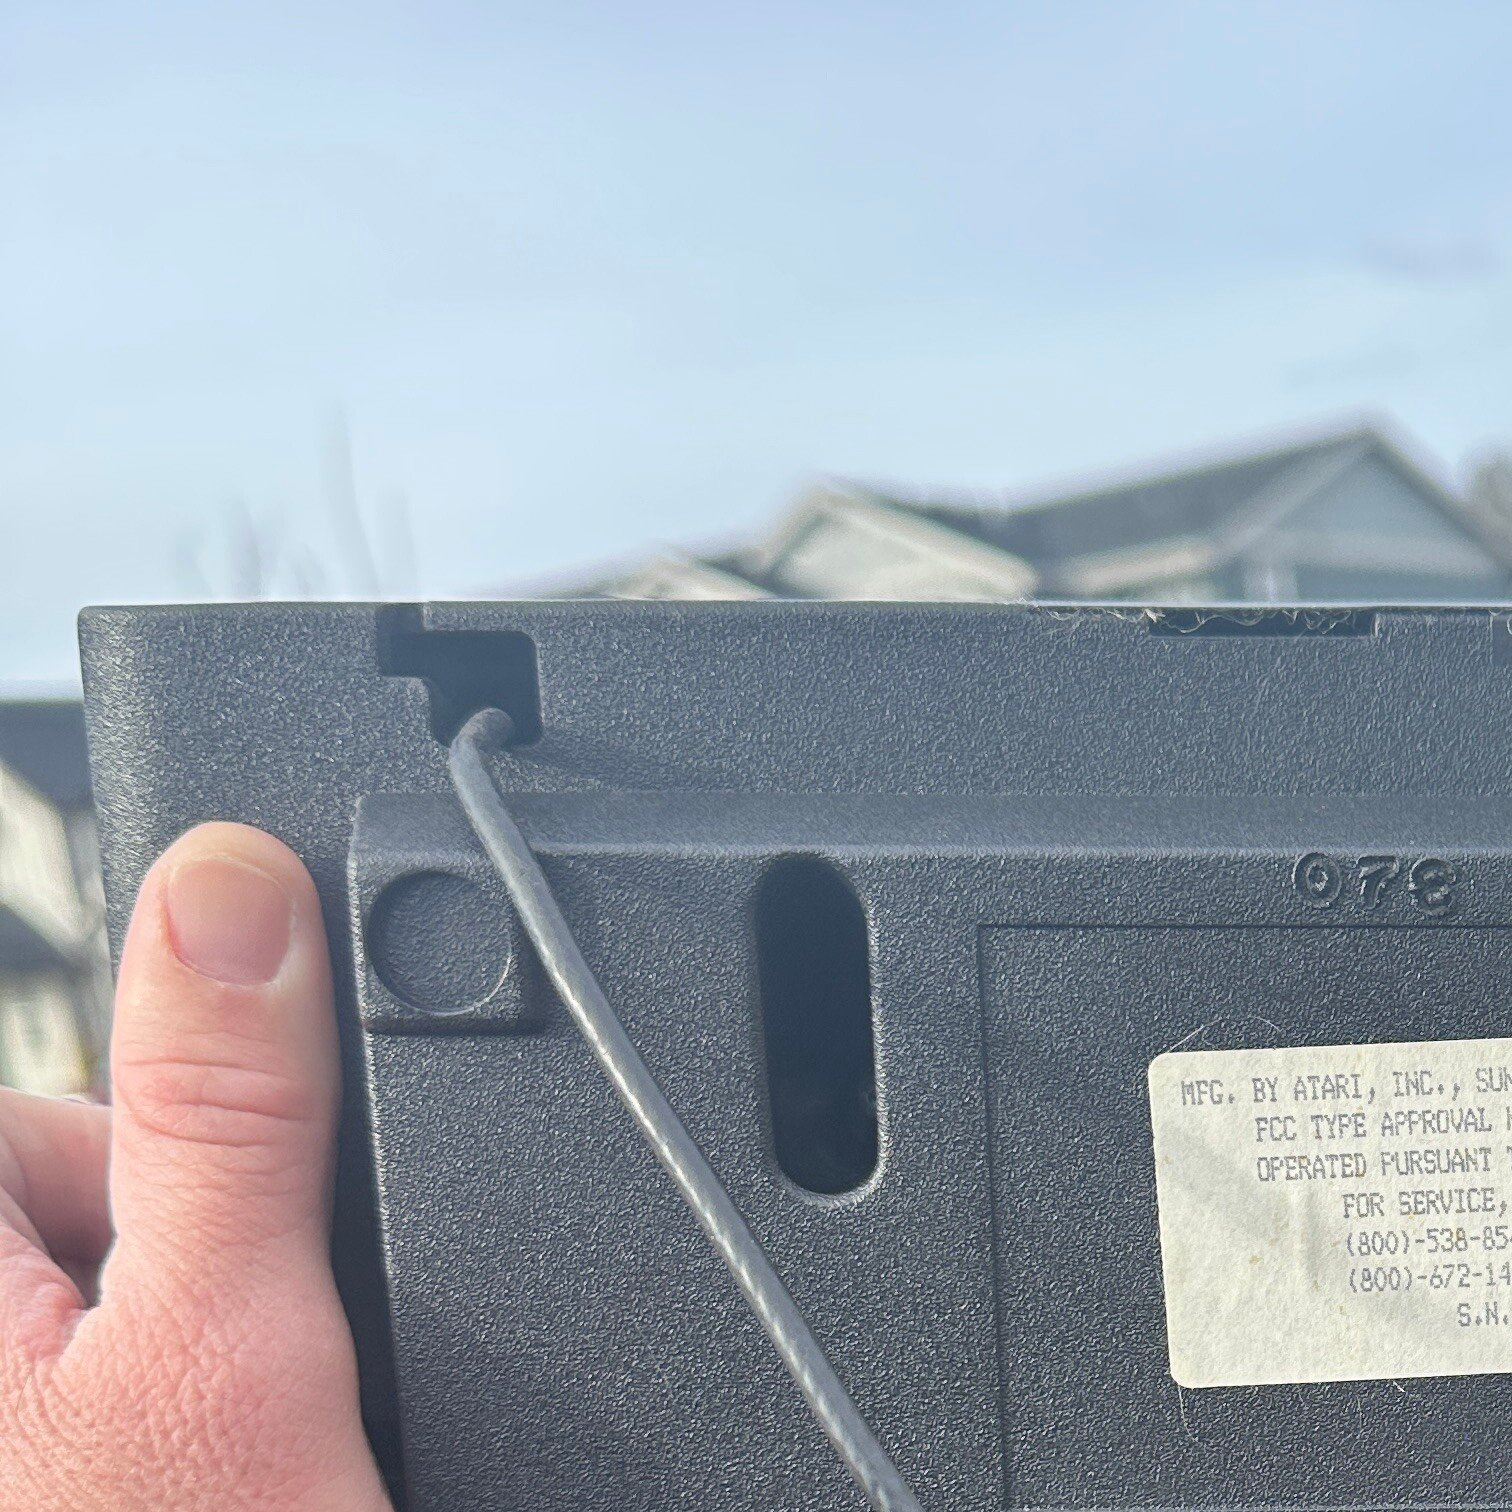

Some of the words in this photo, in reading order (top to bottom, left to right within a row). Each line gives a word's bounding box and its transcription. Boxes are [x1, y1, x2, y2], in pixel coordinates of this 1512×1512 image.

[1181, 1078, 1236, 1107] MFG.
[1251, 1076, 1279, 1103] BY
[1292, 1073, 1376, 1105] ATARI,
[1392, 1069, 1462, 1102] INC.,
[1254, 1115, 1298, 1143] FCC
[1309, 1112, 1368, 1140] TYPE
[1380, 1106, 1493, 1138] APPROVAL
[1256, 1152, 1368, 1183] OPERATED
[1380, 1147, 1493, 1178] PURSUANT
[1340, 1192, 1386, 1219] FOR
[1399, 1186, 1508, 1219] SERVICE,
[1456, 1300, 1509, 1328] S.N.
